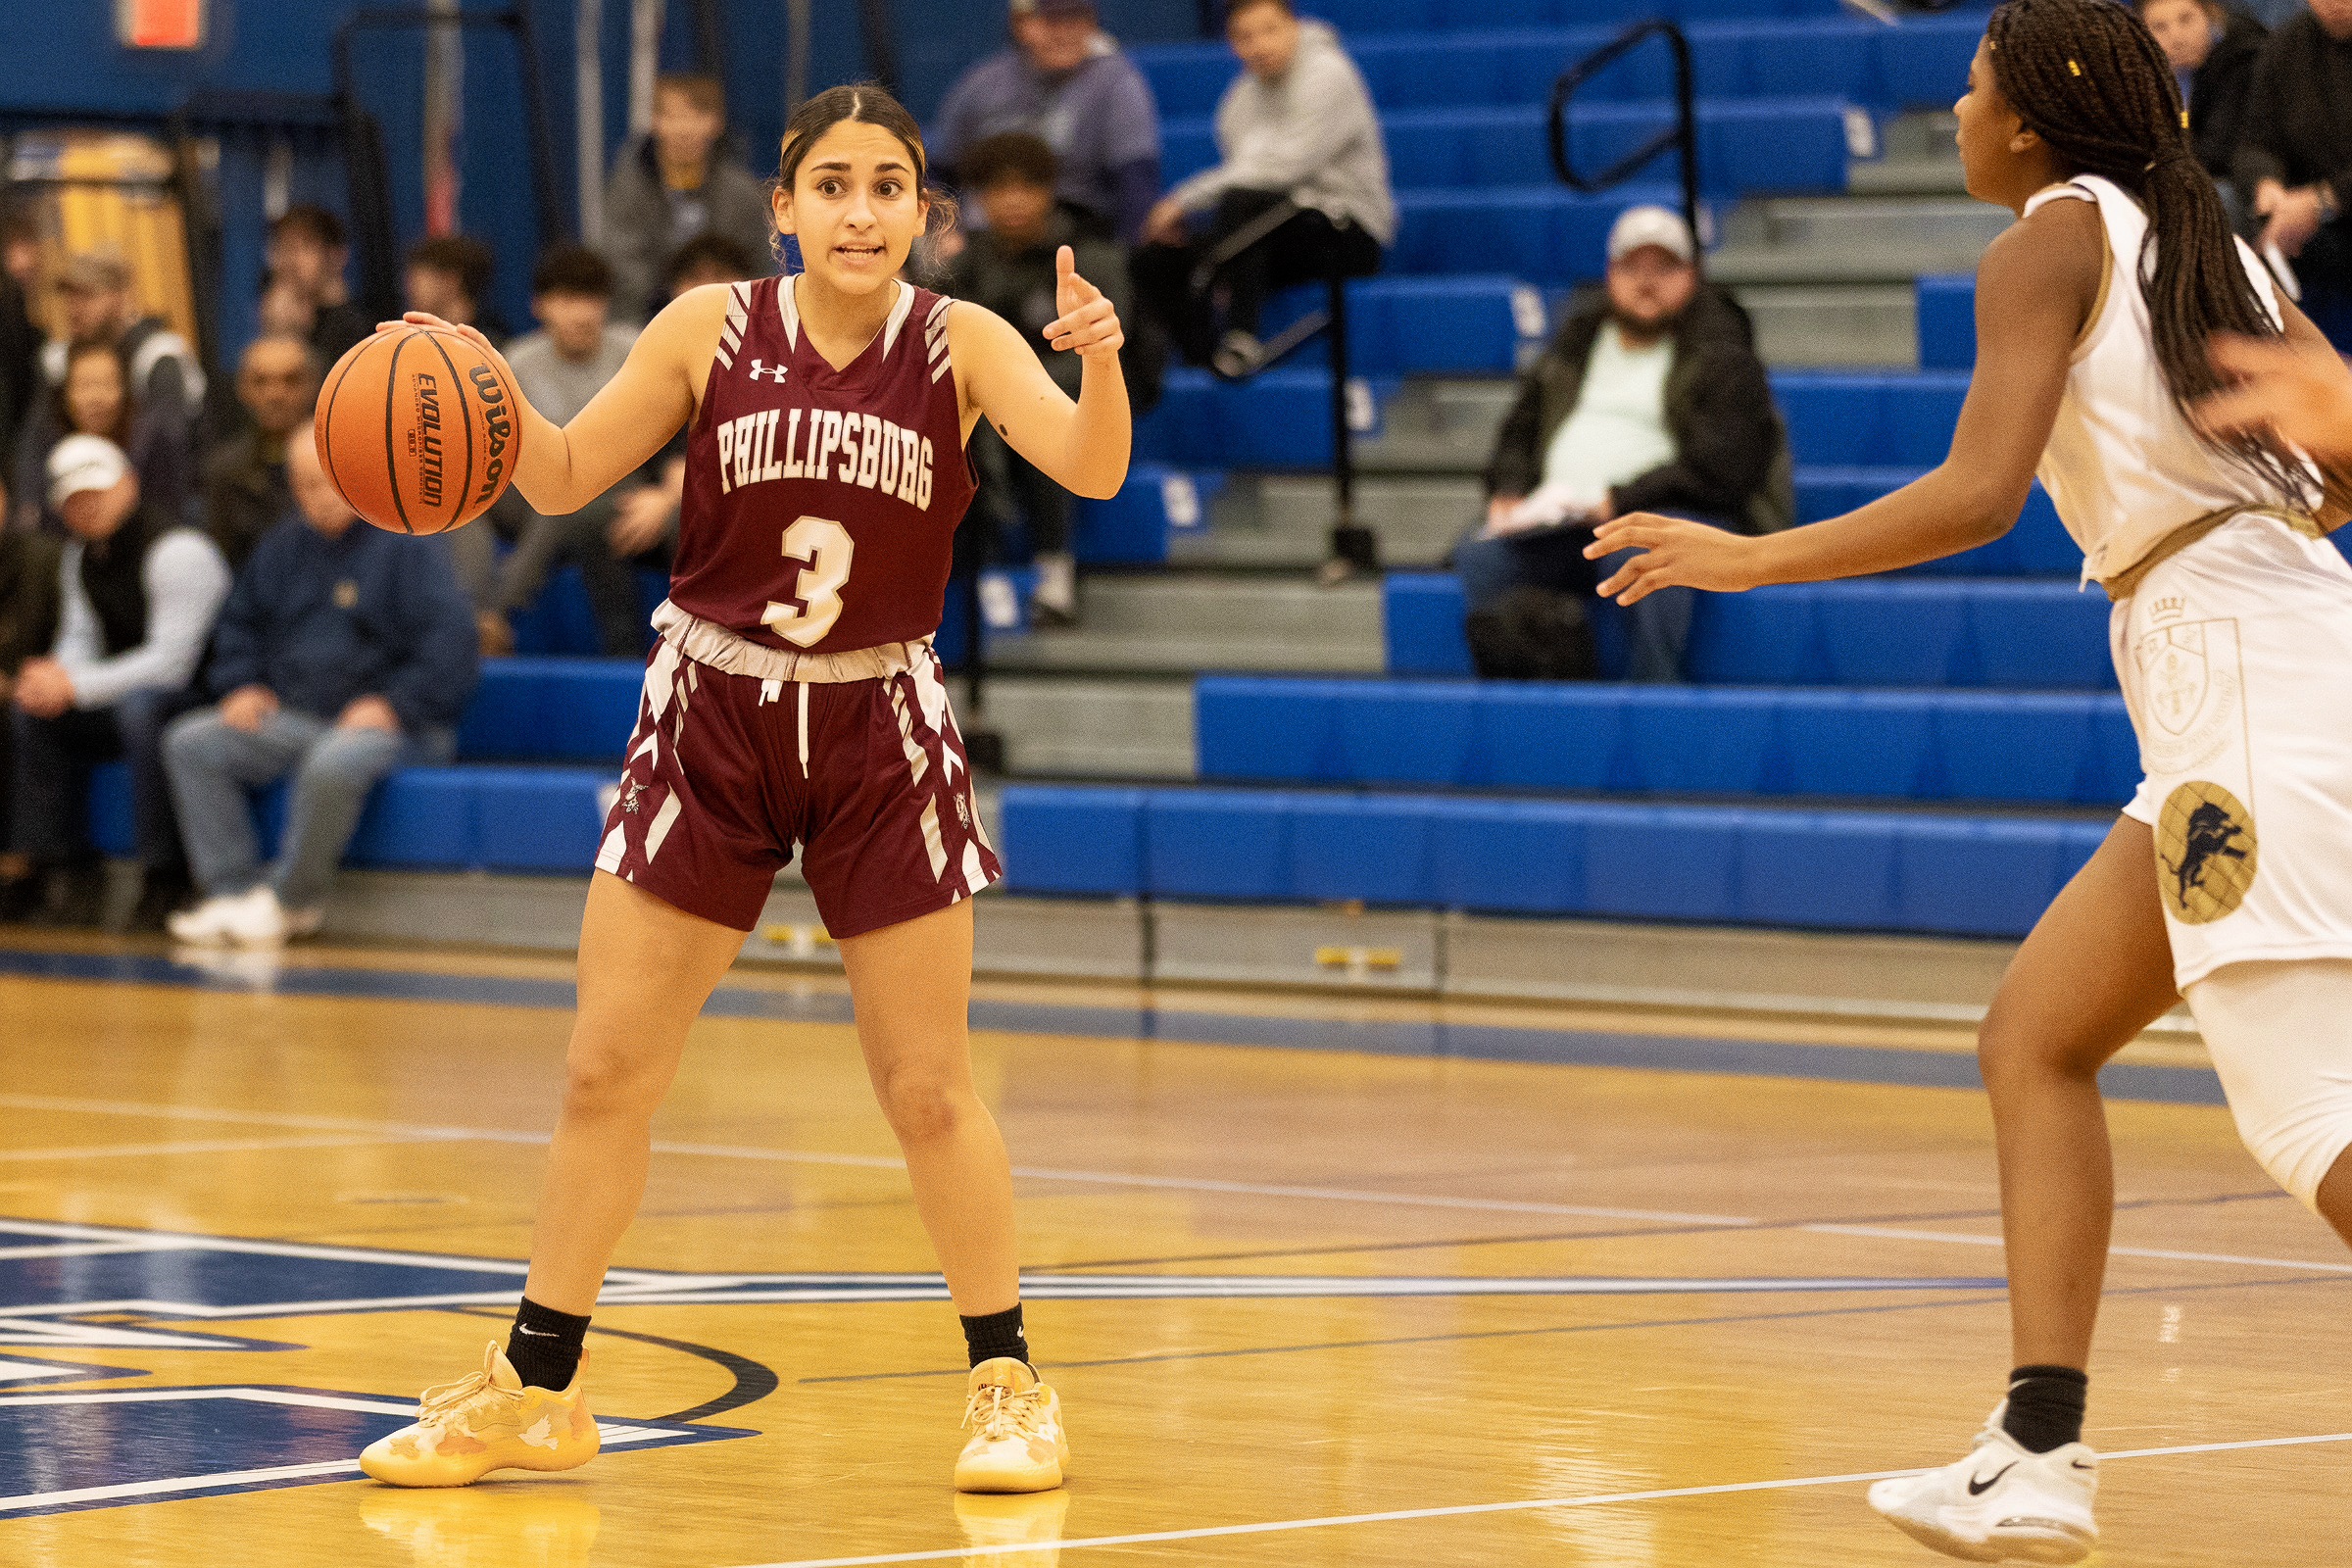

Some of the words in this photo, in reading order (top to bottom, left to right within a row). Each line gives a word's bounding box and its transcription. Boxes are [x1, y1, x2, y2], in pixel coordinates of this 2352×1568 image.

[417, 372, 443, 508] EVOLUTION
[469, 364, 511, 507] Wilson
[716, 408, 934, 512] PHILLIPSBURG
[760, 514, 855, 648] 3
